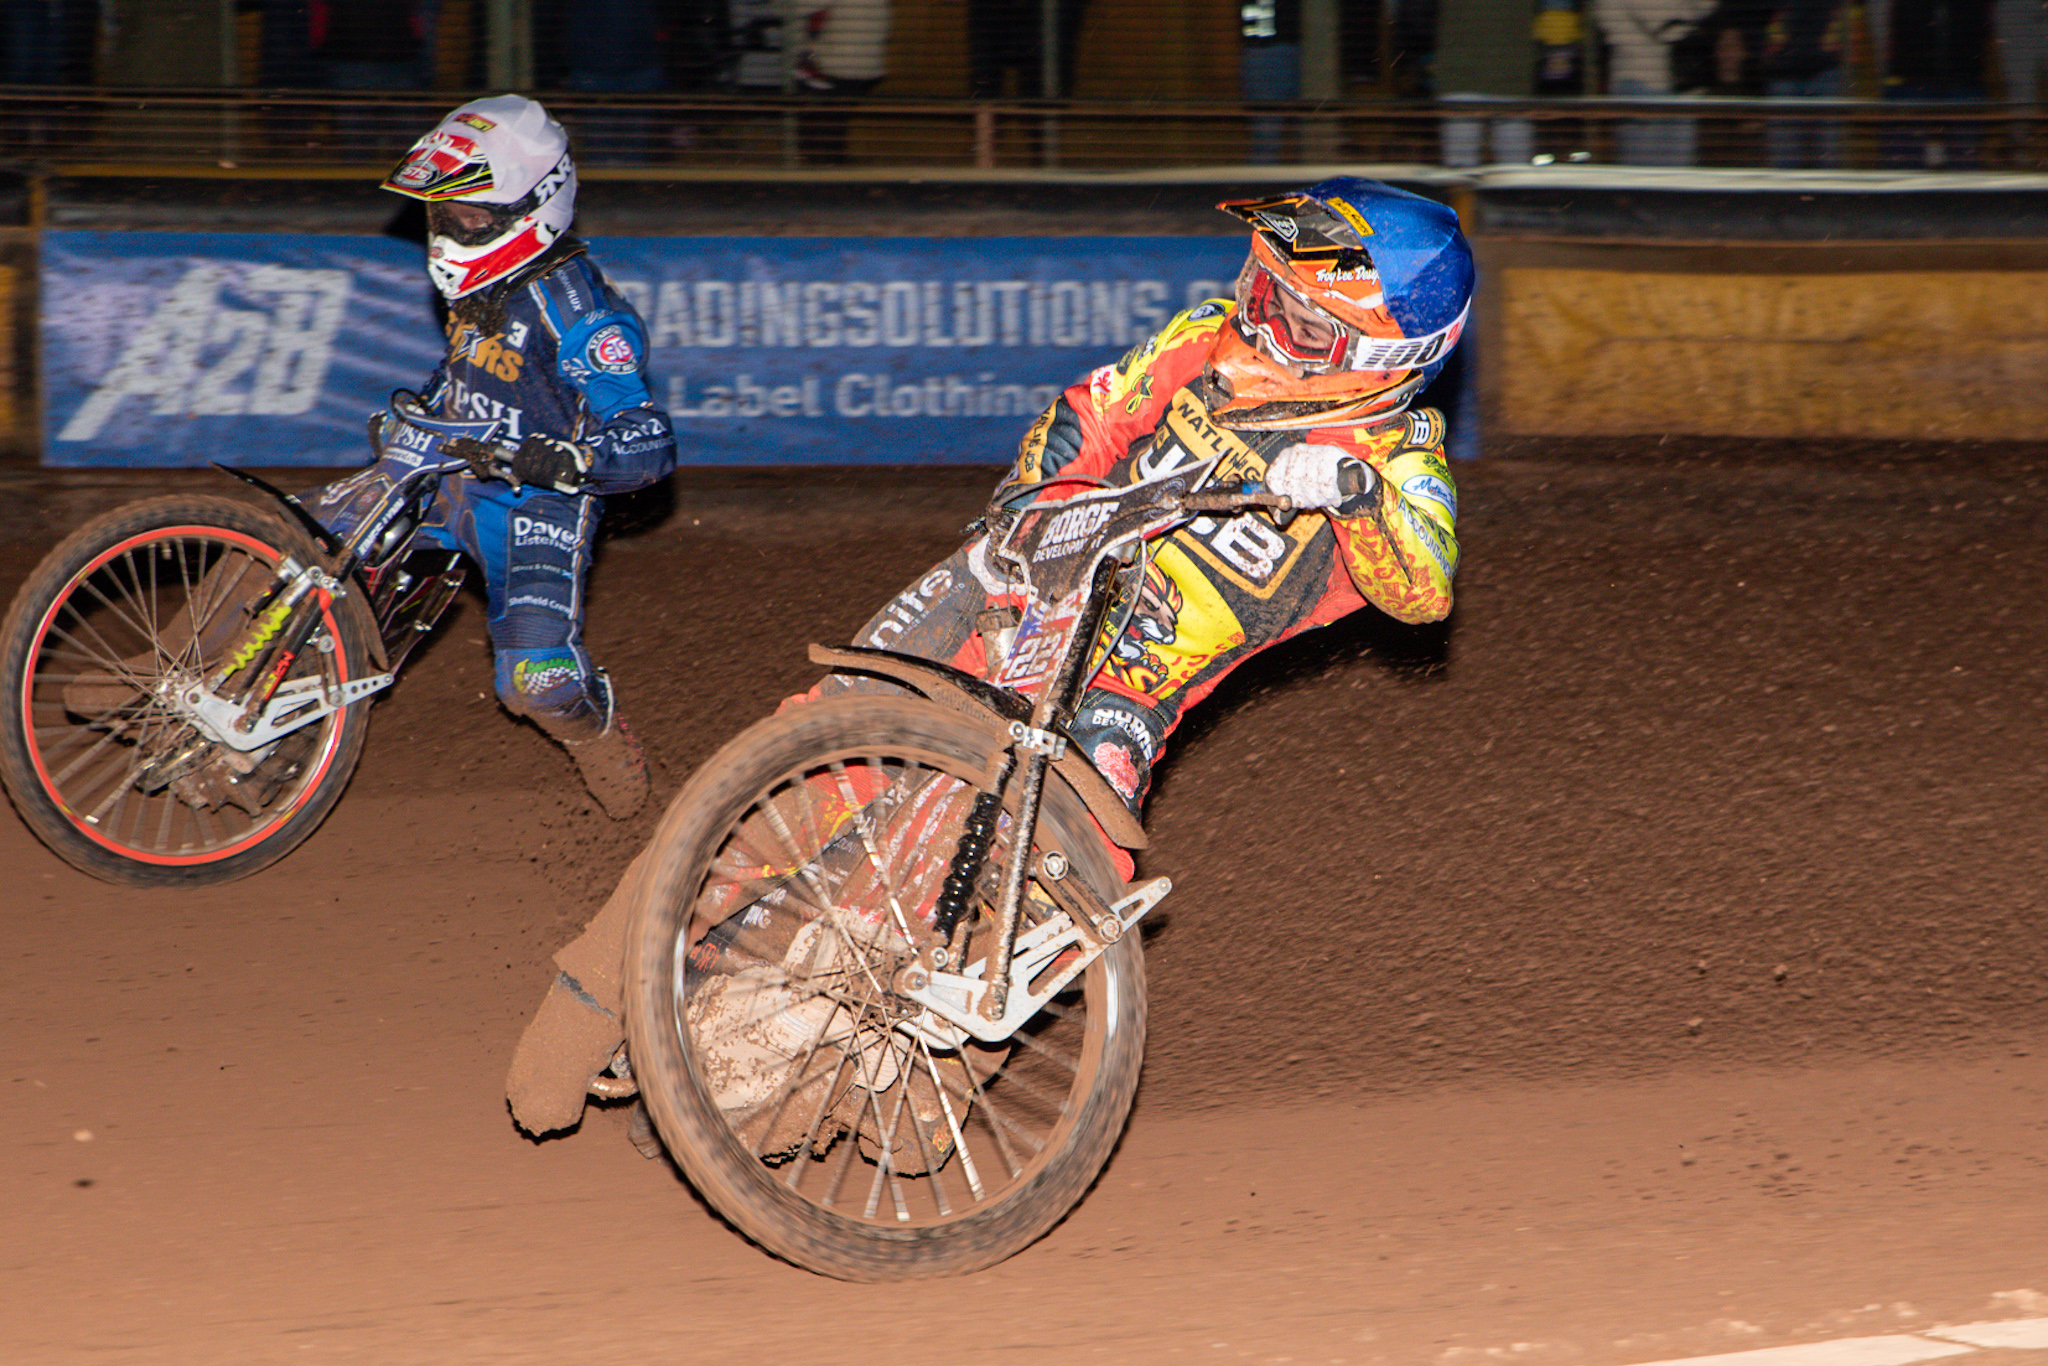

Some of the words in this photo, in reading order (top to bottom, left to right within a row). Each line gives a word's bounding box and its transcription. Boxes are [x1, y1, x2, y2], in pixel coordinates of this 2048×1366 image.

[1315, 268, 1336, 289] Troy
[1336, 267, 1354, 282] Lee
[506, 320, 529, 349] 3
[668, 376, 823, 418] Label
[514, 517, 576, 545] Dave
[1038, 502, 1121, 550] BORGE
